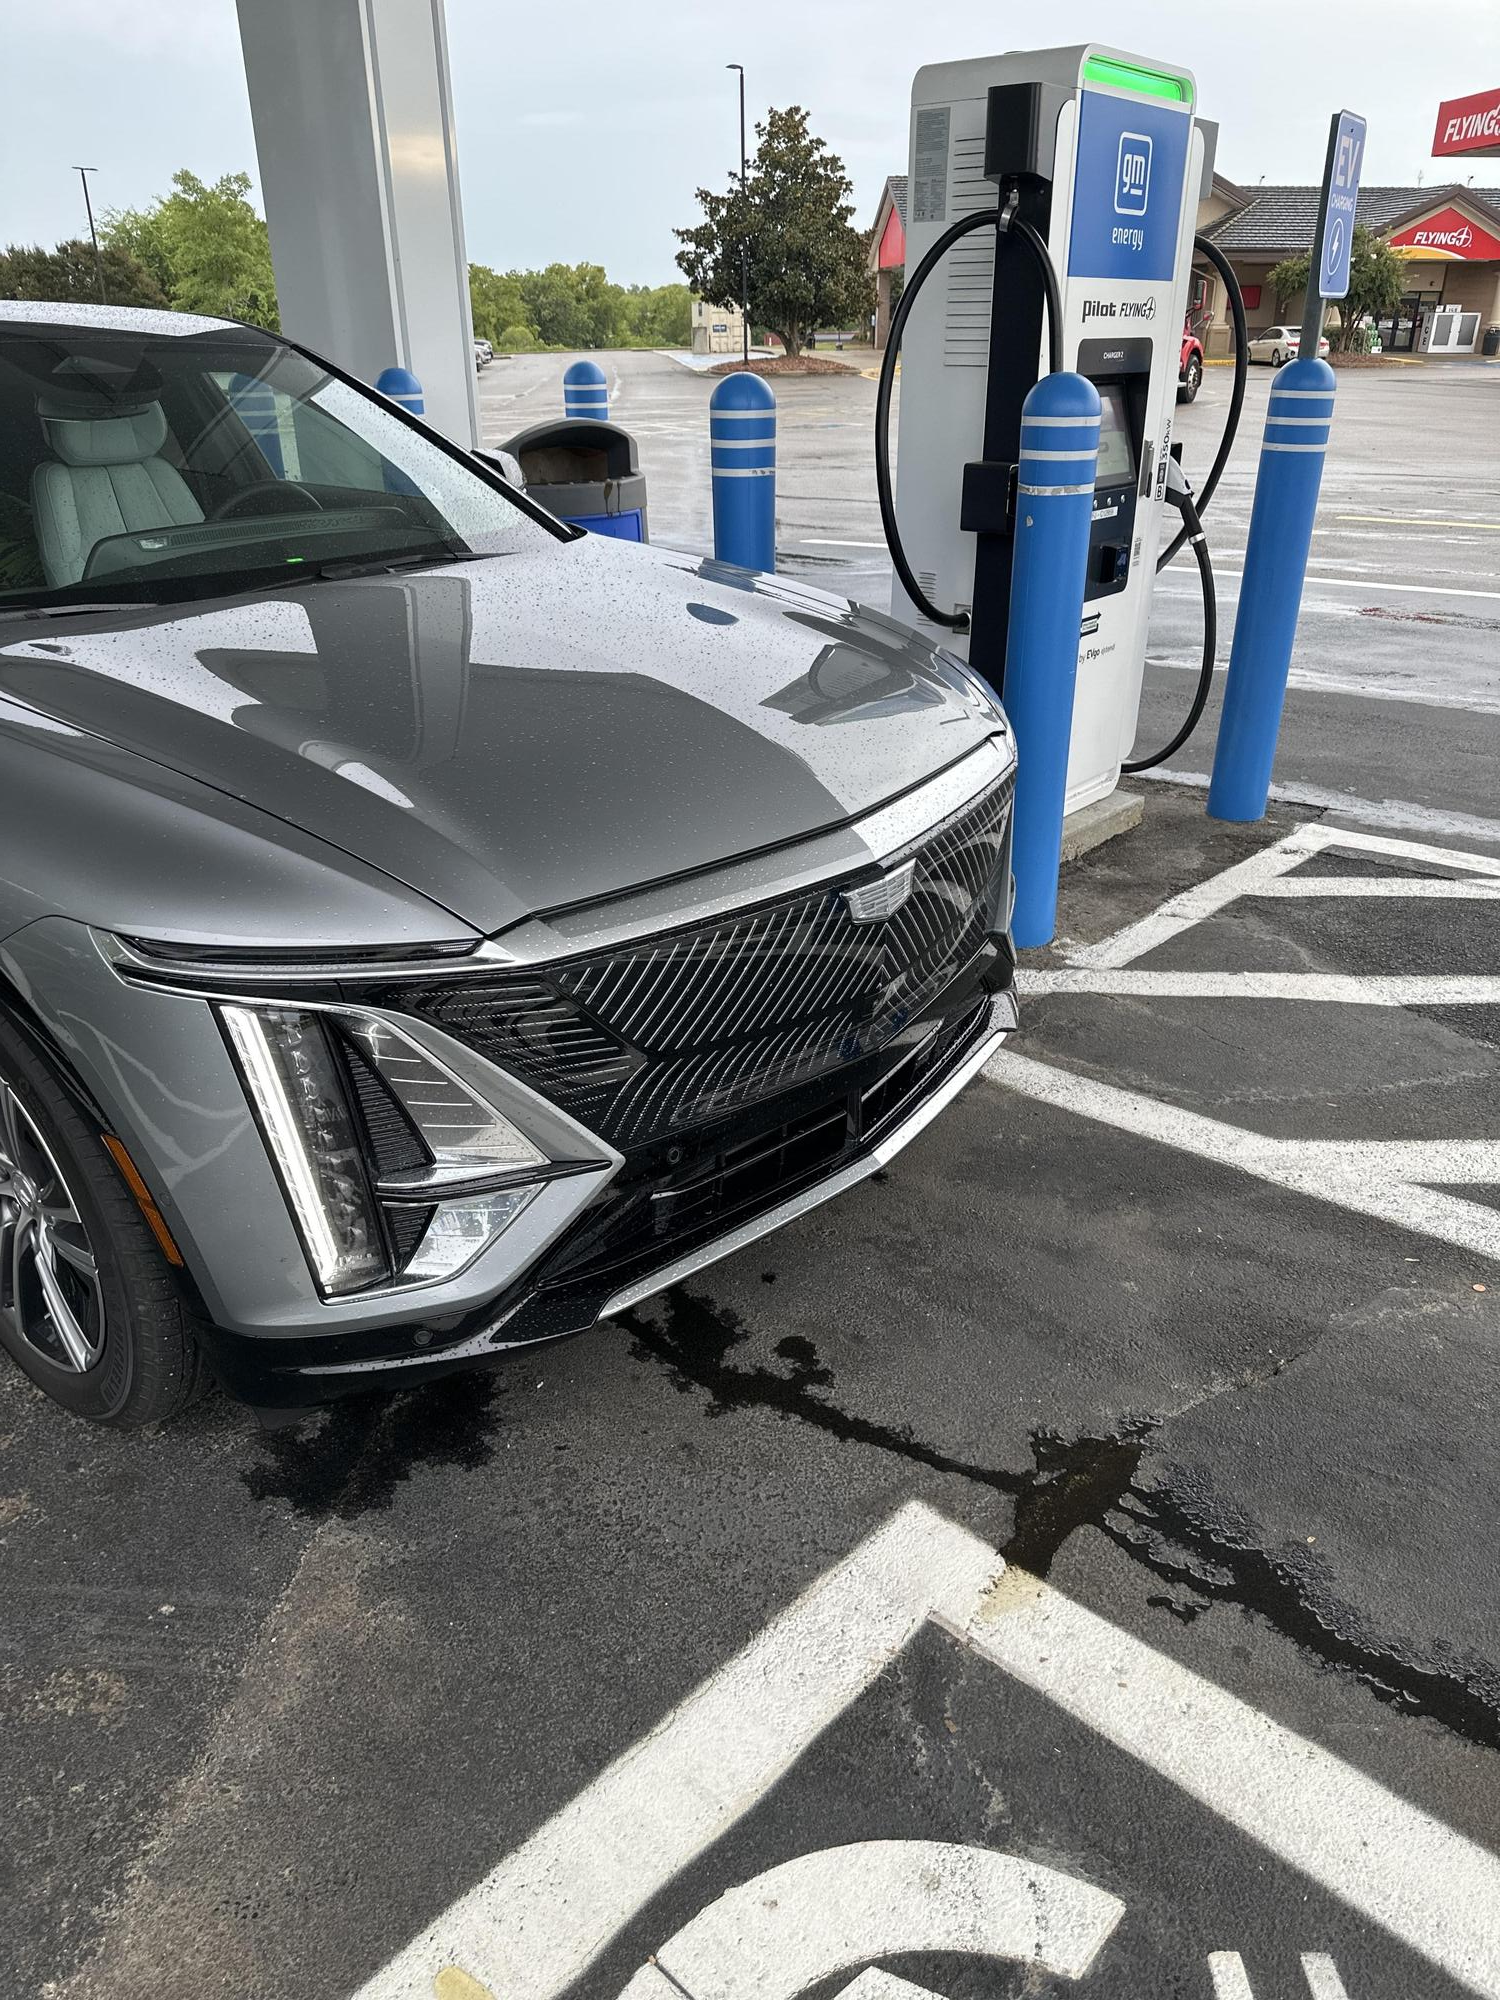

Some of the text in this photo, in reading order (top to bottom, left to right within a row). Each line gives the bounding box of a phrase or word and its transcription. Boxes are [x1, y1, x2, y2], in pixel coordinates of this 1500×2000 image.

[1443, 110, 1496, 143] FLYING
[1123, 153, 1145, 195] gm
[1335, 135, 1360, 189] EV
[1331, 193, 1353, 212] CHARGING
[1112, 227, 1144, 251] energy
[1413, 231, 1457, 245] FLYING
[1120, 303, 1147, 317] FLYING
[1421, 315, 1431, 346] ICE
[1162, 418, 1172, 460] 350kW
[1086, 648, 1100, 660] EVgo
